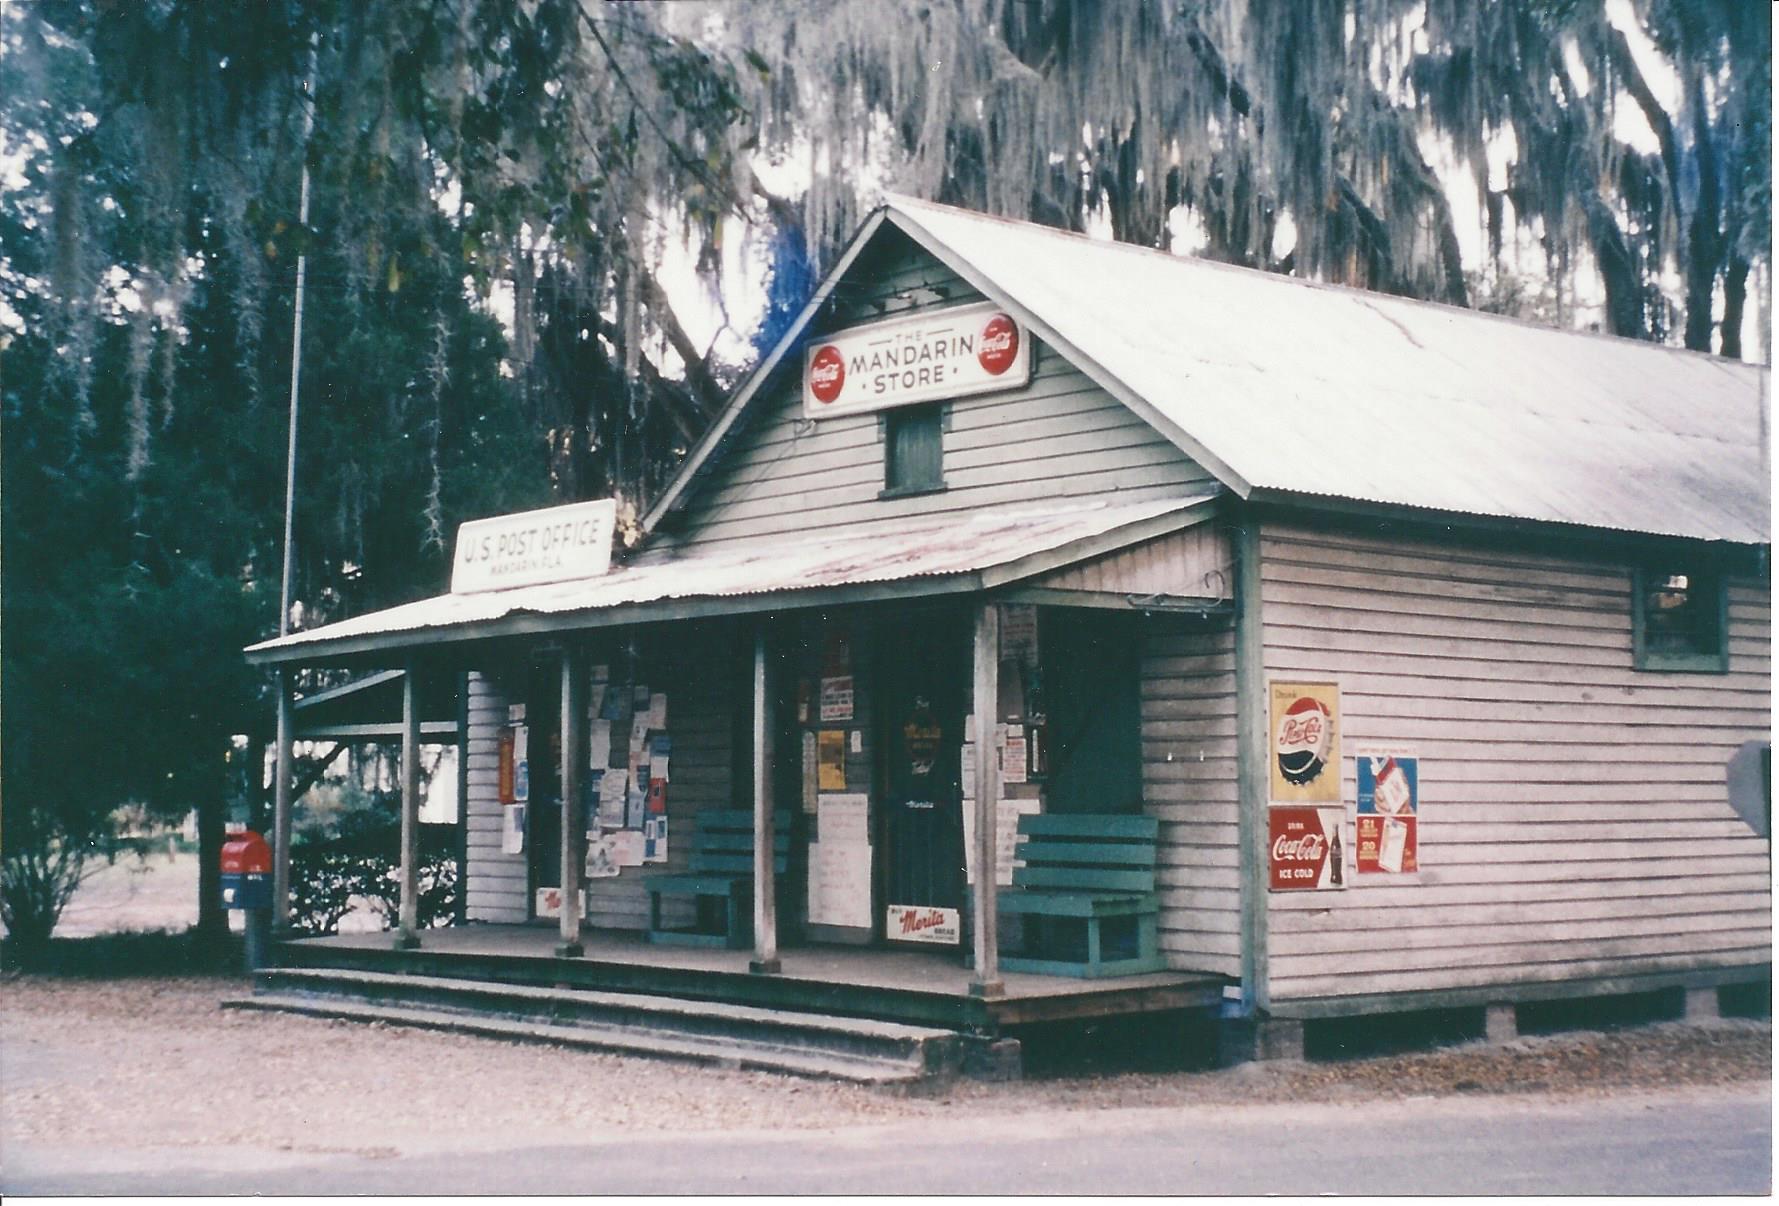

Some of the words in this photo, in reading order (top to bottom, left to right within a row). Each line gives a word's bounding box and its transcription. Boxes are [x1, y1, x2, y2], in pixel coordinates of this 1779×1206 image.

[896, 330, 923, 343] THE
[848, 334, 974, 376] MANDARIN
[874, 365, 945, 394] STORE
[497, 529, 537, 557] POST
[542, 519, 600, 550] OFFICE
[1273, 834, 1324, 861] Coca-Cola
[1362, 841, 1376, 850] 20
[1280, 869, 1292, 879] ICE
[1294, 868, 1314, 878] COLD
[900, 909, 945, 934] Merita
